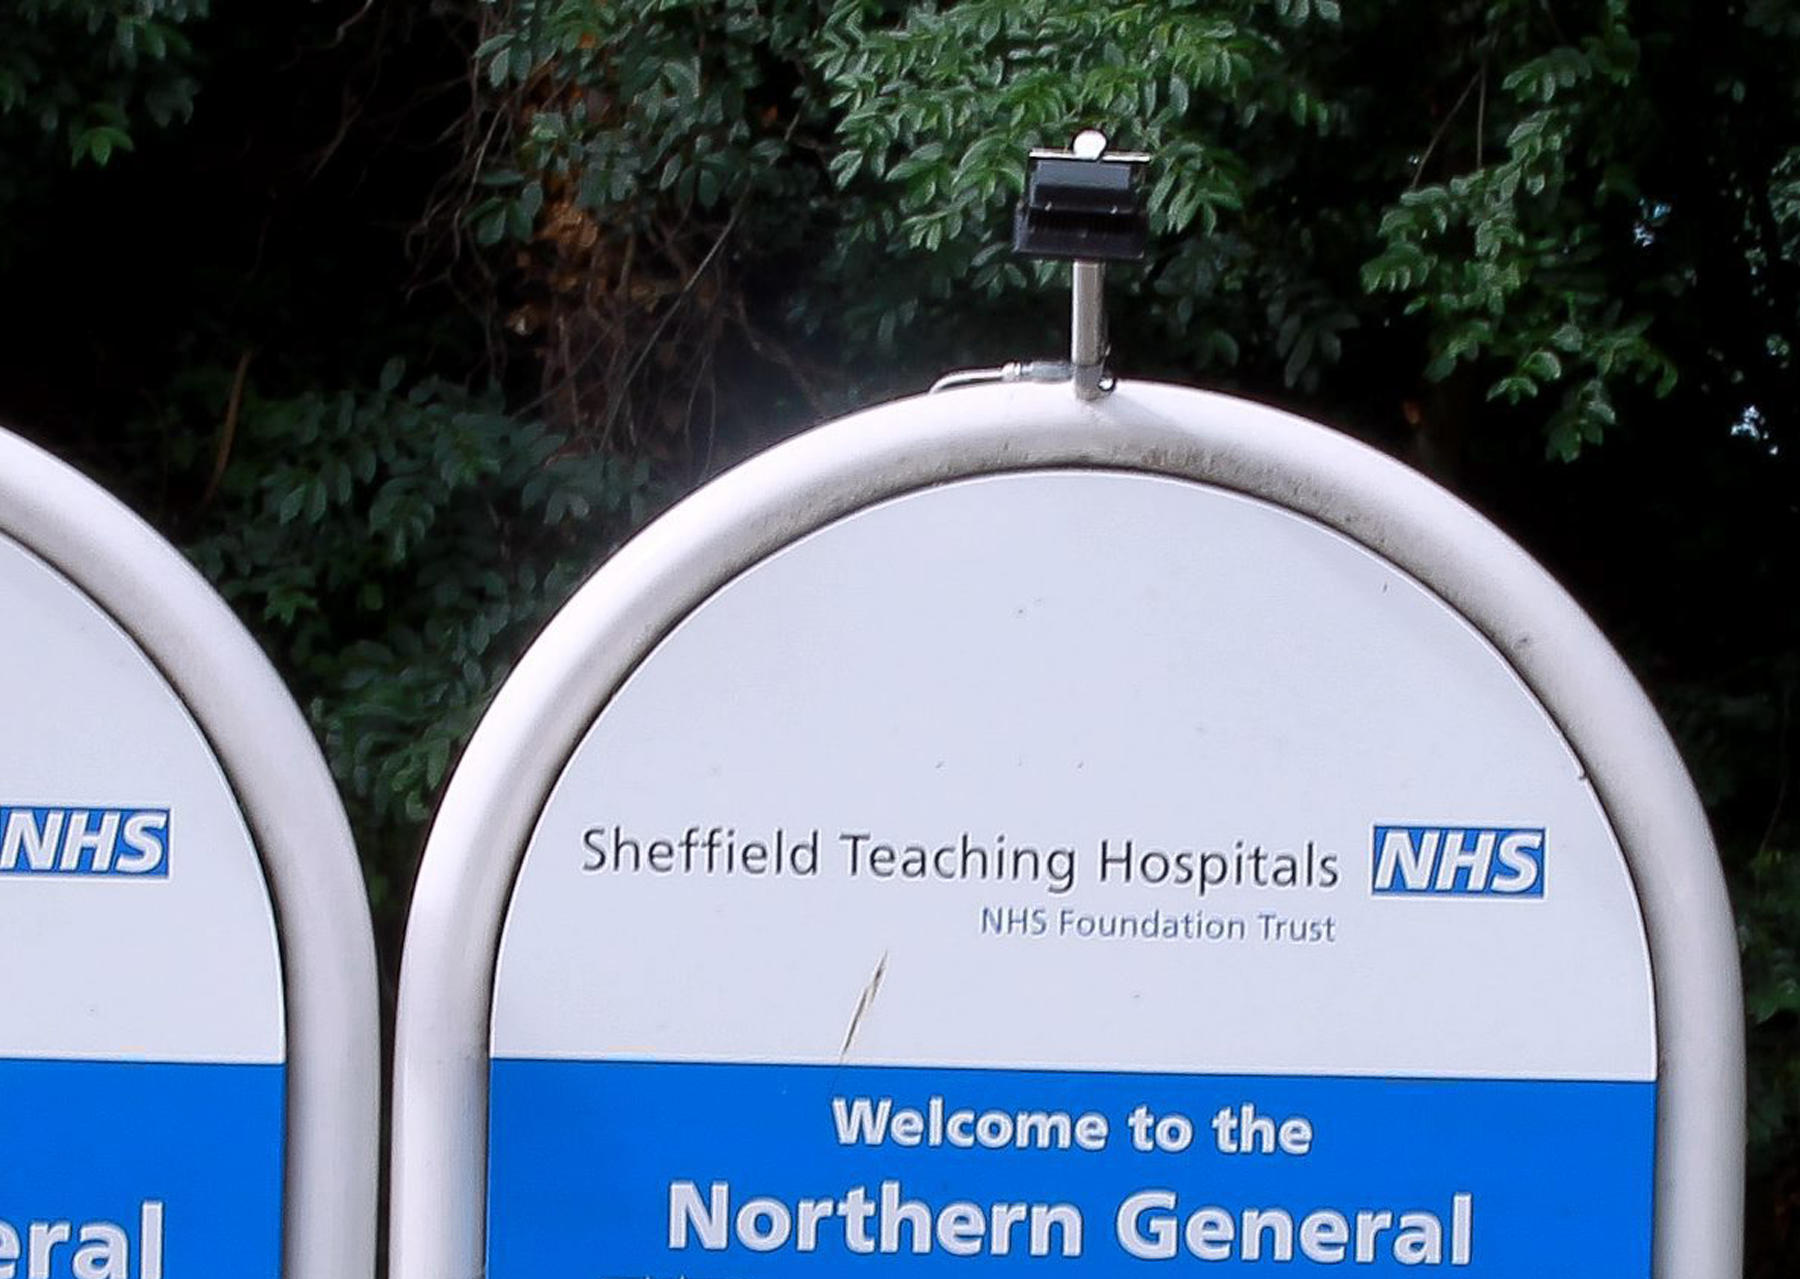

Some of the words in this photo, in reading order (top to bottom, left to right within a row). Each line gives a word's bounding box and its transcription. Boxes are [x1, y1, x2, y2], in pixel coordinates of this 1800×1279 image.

[582, 824, 819, 876] Sheffield
[838, 831, 1076, 895] Teaching
[1099, 838, 1339, 897] Hospitals
[1373, 827, 1544, 893] NHS
[980, 906, 1047, 936] NHS
[1059, 908, 1246, 941] Foundation
[1257, 911, 1336, 943] Trust
[831, 1096, 1109, 1150] Welcome
[1127, 1105, 1193, 1152] to
[1211, 1103, 1313, 1155] the
[669, 1180, 1082, 1257] Northern
[1116, 1190, 1472, 1265] General
